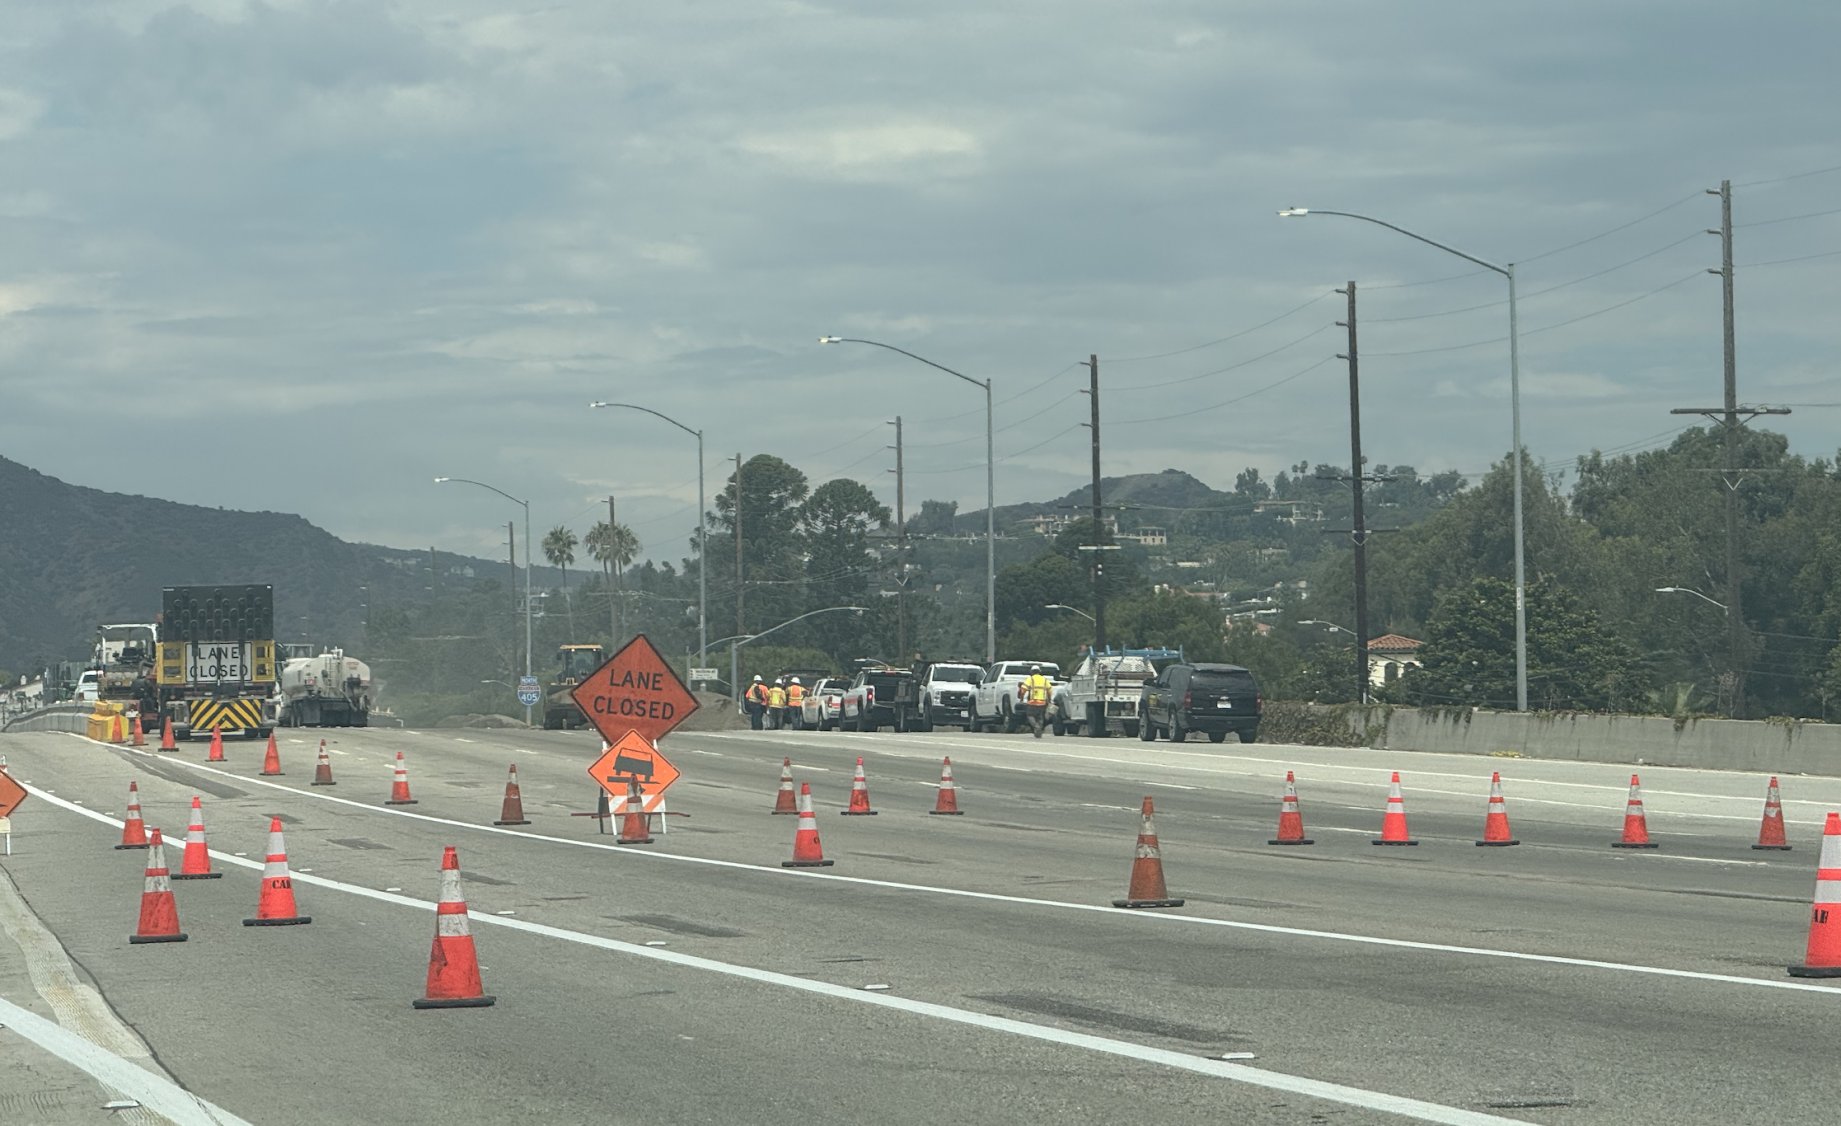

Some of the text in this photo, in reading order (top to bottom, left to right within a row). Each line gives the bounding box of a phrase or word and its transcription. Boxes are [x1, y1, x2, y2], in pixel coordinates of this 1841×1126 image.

[198, 647, 239, 659] LANE
[190, 665, 248, 678] CLOSED
[521, 676, 537, 684] NORTH
[609, 668, 663, 691] LANE
[521, 693, 538, 702] 405
[593, 695, 674, 720] CLOSED
